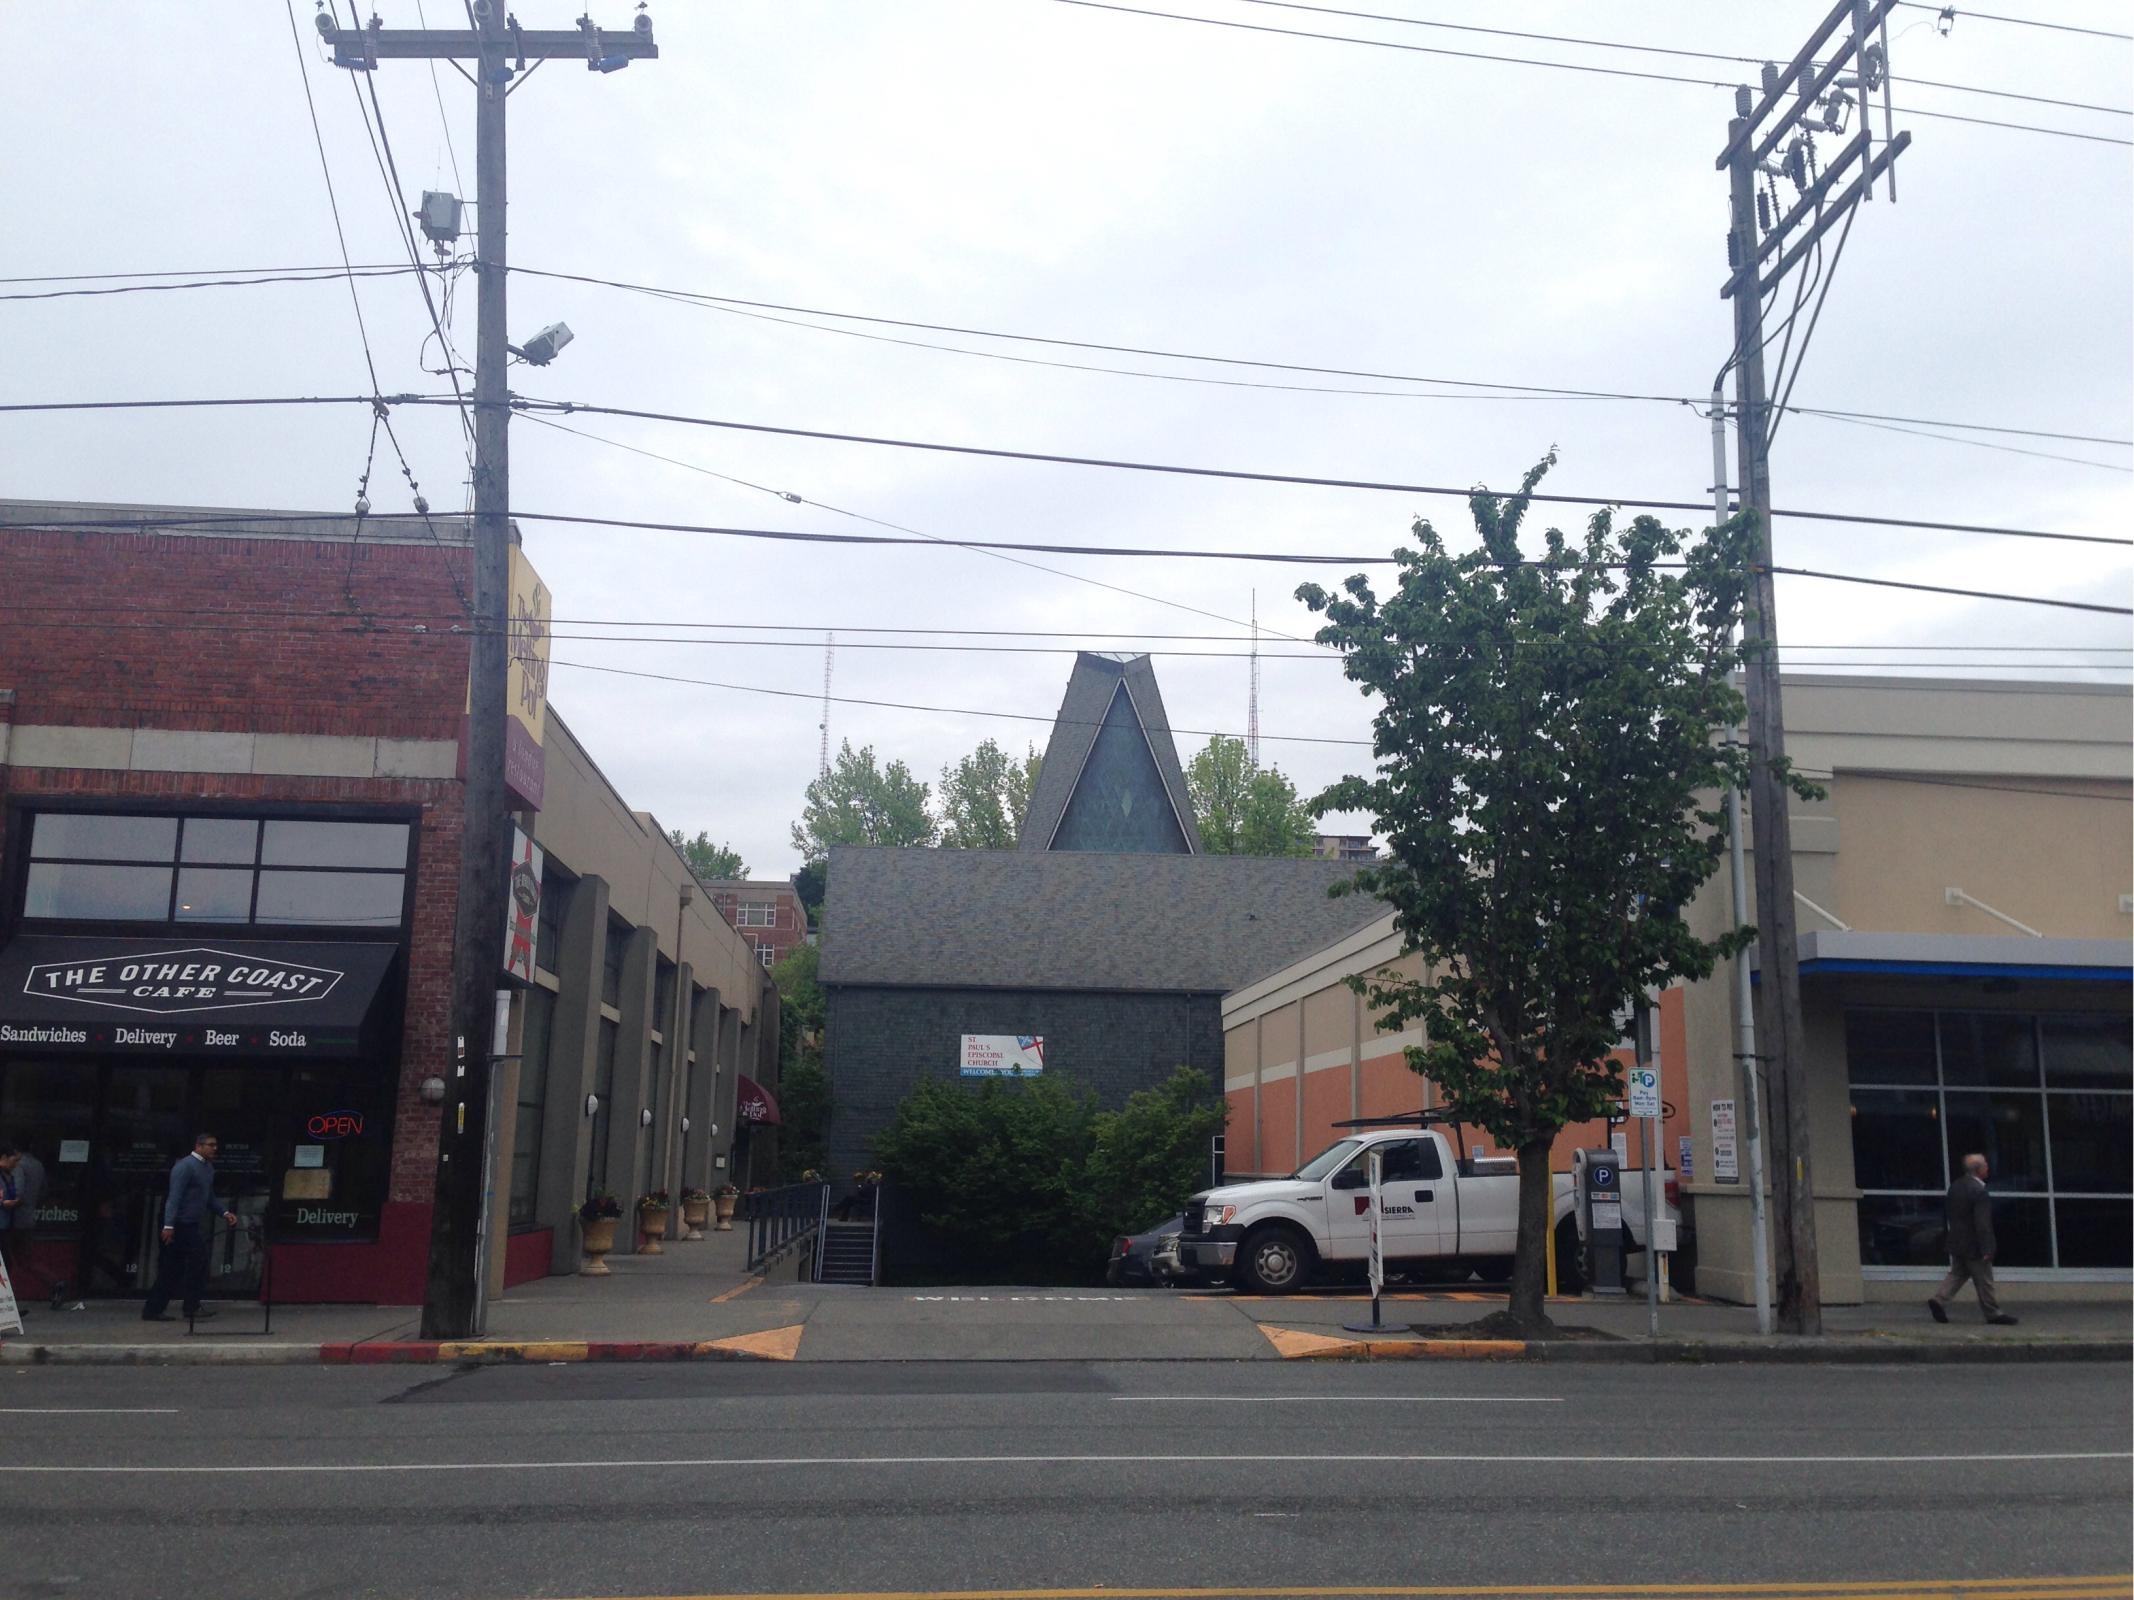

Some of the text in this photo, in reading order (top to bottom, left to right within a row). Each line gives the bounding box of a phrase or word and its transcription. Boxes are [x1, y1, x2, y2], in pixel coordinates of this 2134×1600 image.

[520, 670, 538, 720] Pot
[45, 964, 324, 994] THE OTHER COAST
[133, 985, 217, 998] CAFE
[0, 1025, 307, 1048] Sandwiches Delivery Beer Soda
[967, 1051, 1004, 1059] EPISCOPAL
[308, 1116, 364, 1136] OPEN
[296, 1207, 359, 1229] Delivery
[1384, 1206, 1415, 1215] SIERRA
